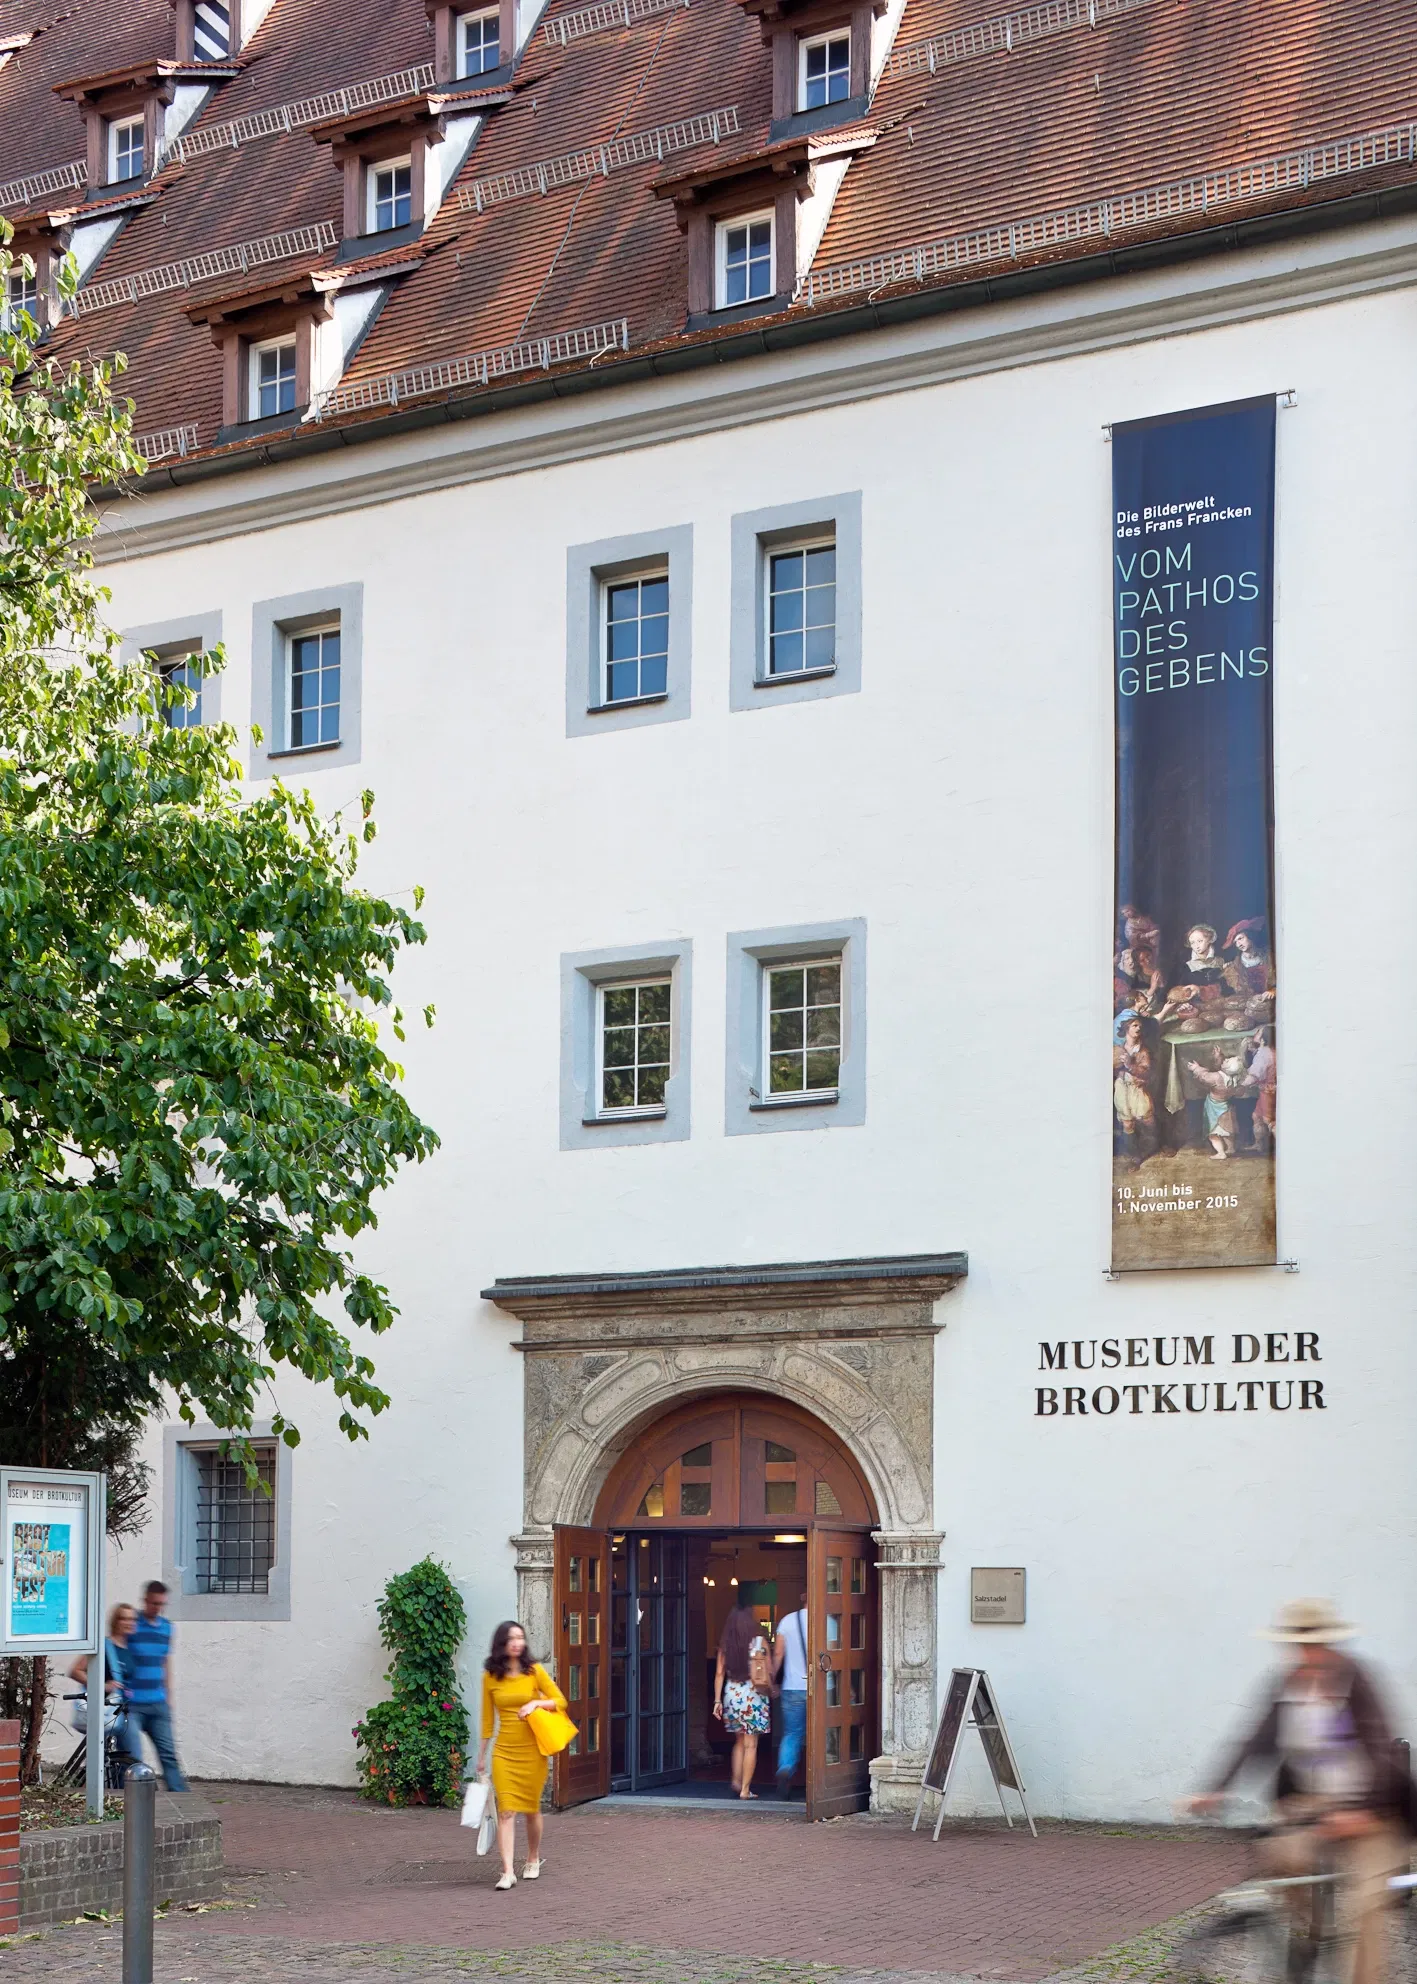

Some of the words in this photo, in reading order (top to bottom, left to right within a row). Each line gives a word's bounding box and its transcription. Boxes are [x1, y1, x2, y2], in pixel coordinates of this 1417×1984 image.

[1117, 511, 1139, 524] Die
[1144, 496, 1215, 520] Bilderwelt
[1117, 525, 1141, 538] des
[1145, 519, 1183, 534] Frans
[1187, 506, 1252, 526] Francken
[1116, 542, 1191, 582] VOM
[1120, 571, 1259, 620] PATHOS
[1120, 620, 1188, 659] DES
[1119, 646, 1269, 696] GEBENS
[1117, 1187, 1135, 1199] 10.
[1138, 1184, 1168, 1198] Juni
[1172, 1184, 1193, 1196] bis
[1117, 1202, 1127, 1214] 1.
[1130, 1199, 1201, 1213] November
[1206, 1195, 1238, 1208] 2015
[1037, 1335, 1215, 1370] MUSEUM
[1231, 1332, 1323, 1363] DER
[1034, 1379, 1327, 1416] BROTKULTUR
[8, 1488, 29, 1499] USEUM
[32, 1489, 44, 1500] DER
[47, 1490, 82, 1502] BROTKULTUR
[12, 1576, 46, 1602] FEST
